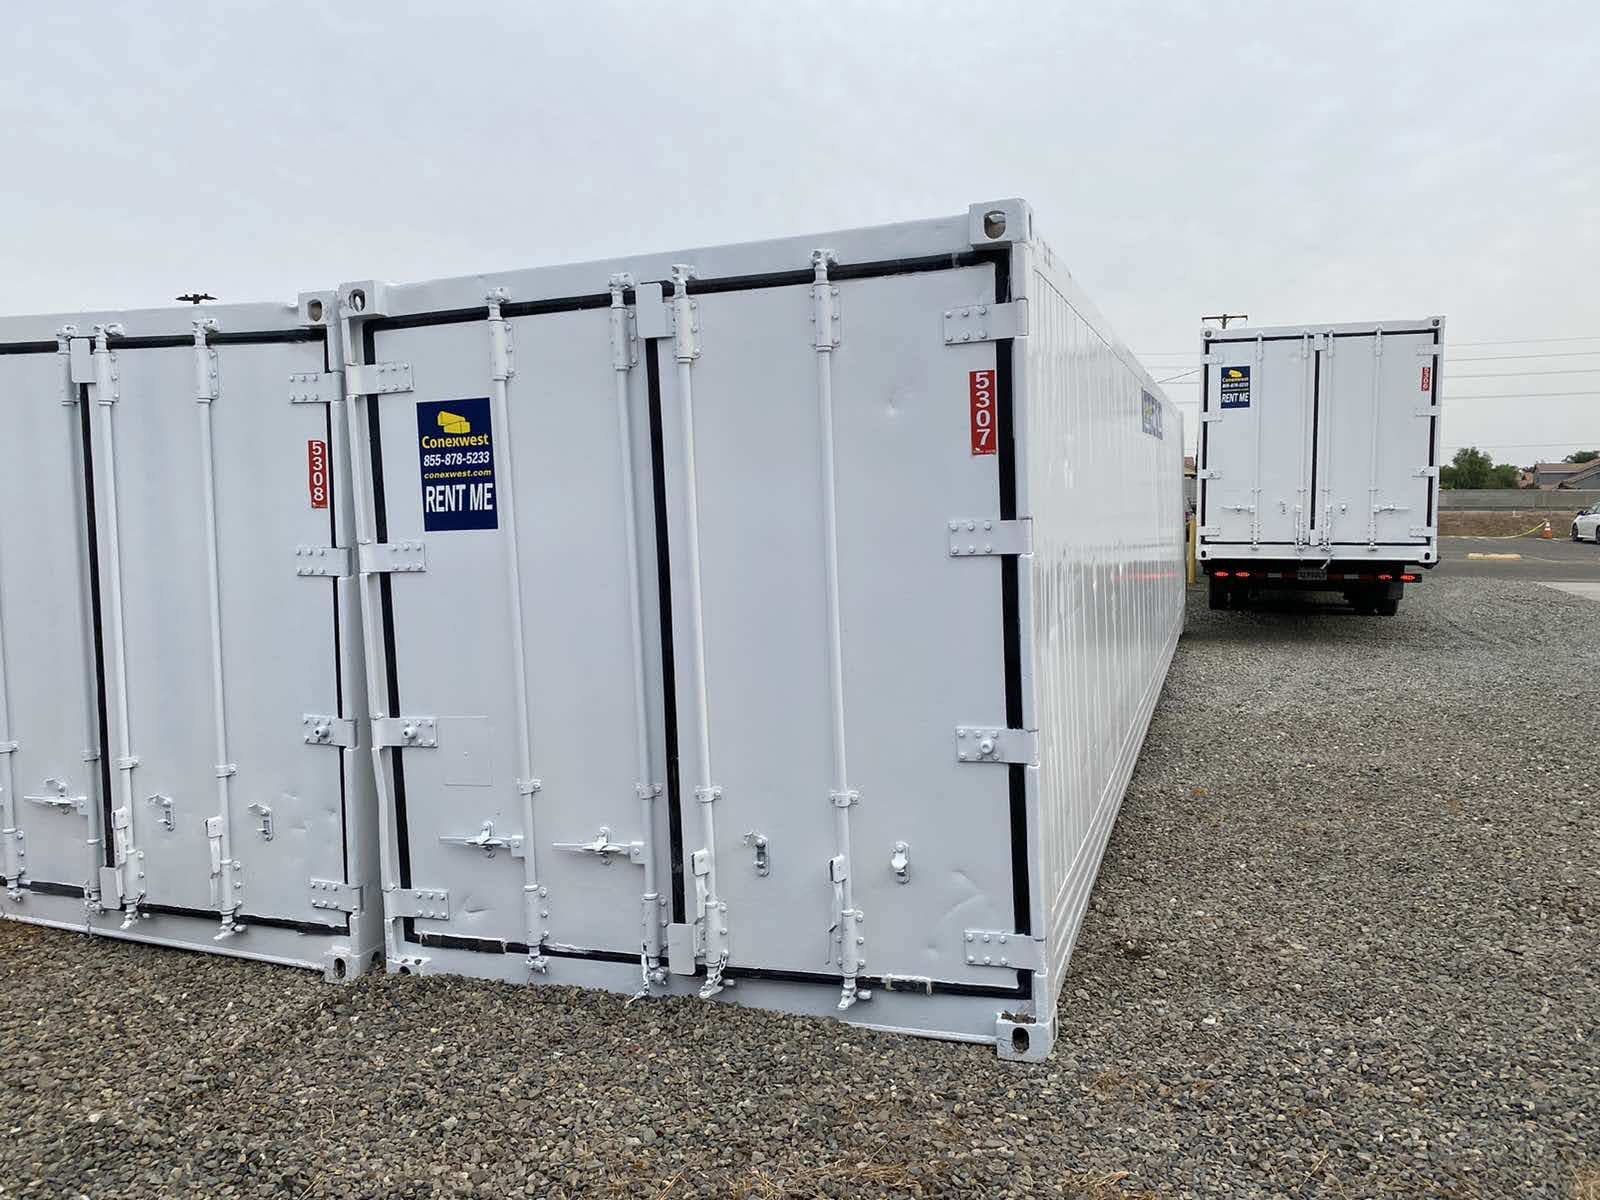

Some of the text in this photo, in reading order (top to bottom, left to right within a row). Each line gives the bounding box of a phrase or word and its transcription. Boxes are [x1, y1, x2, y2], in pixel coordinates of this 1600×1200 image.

[1222, 392, 1249, 403] RENT ME
[975, 371, 991, 446] 5307
[421, 434, 489, 449] Conexwest
[423, 451, 490, 467] 855-878-5233
[312, 441, 324, 501] 5308
[424, 469, 492, 480] conexwest.com
[425, 483, 494, 513] RENT ME
